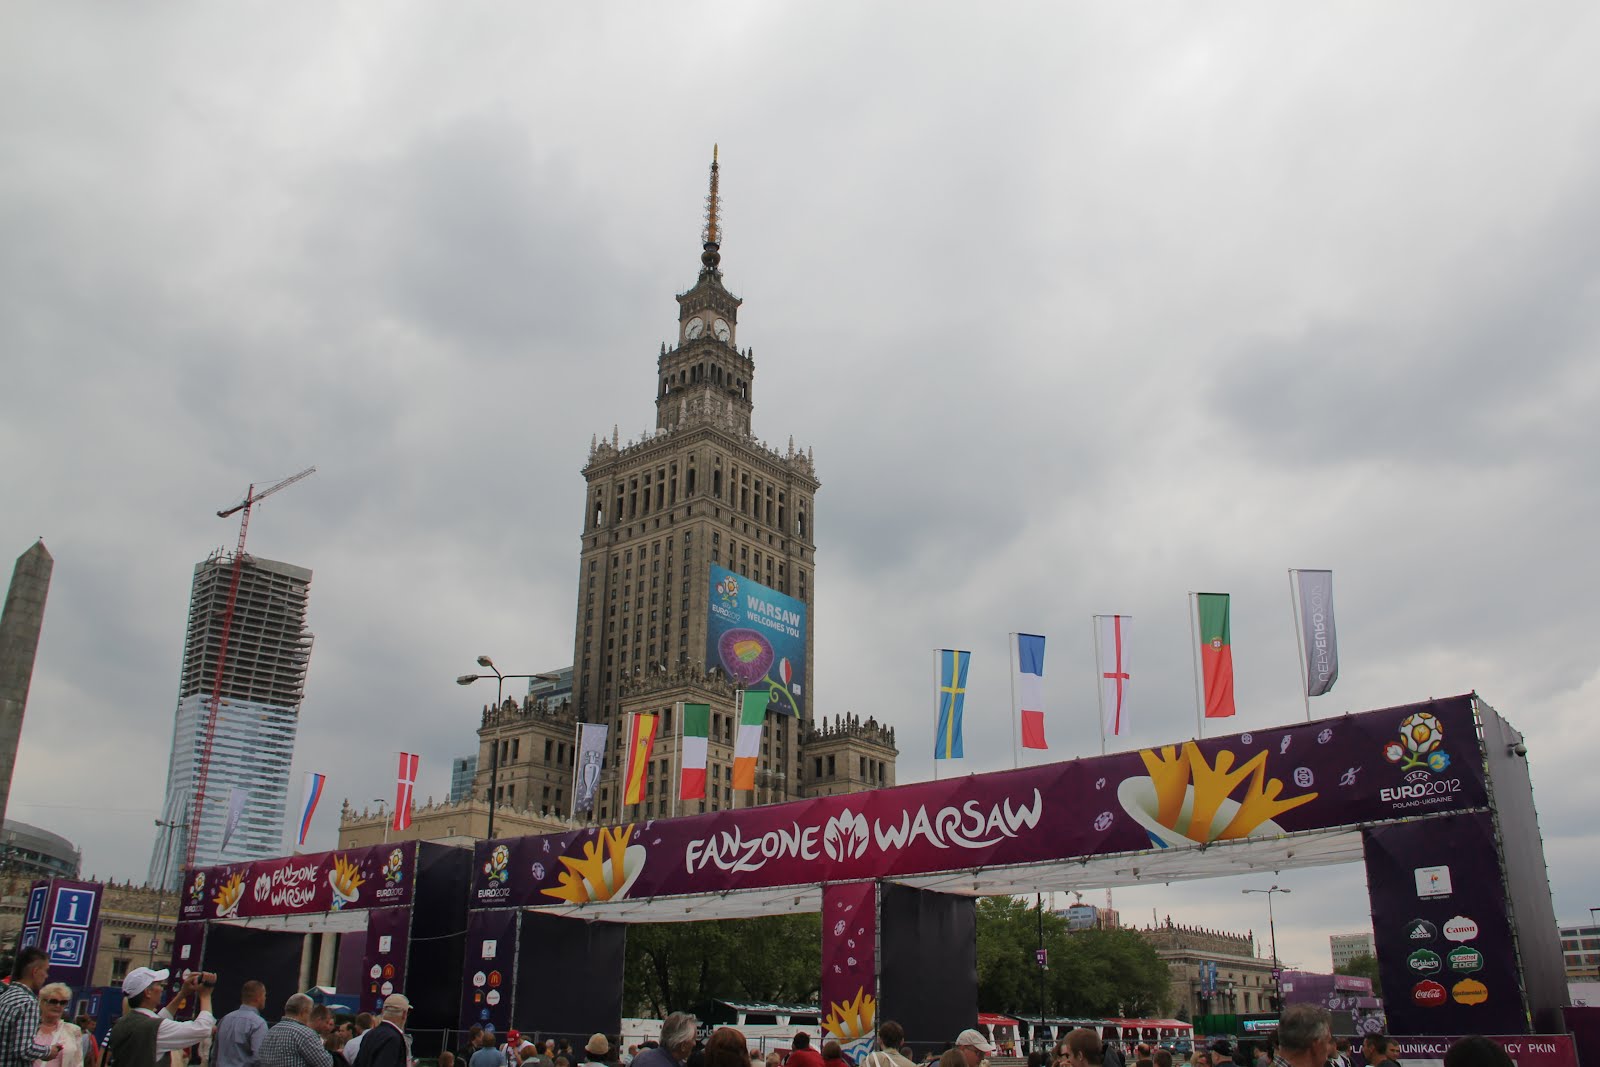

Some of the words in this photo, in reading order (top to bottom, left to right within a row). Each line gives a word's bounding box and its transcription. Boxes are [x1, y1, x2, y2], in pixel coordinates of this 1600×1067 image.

[747, 595, 801, 627] WARSAW
[747, 611, 785, 632] WELCOMES
[785, 625, 800, 638] YOU
[1406, 772, 1429, 782] UEFA
[1380, 778, 1462, 801] EURO2012
[685, 820, 821, 875] FANZONE
[874, 787, 1043, 850] WARSAW
[271, 863, 319, 887] FANZONE
[271, 884, 316, 908] WARSAW
[478, 887, 510, 898] EURO2012
[1446, 925, 1475, 934] Canon
[1409, 957, 1439, 971] Carlsberg
[1452, 961, 1479, 969] EDGE
[1503, 1043, 1521, 1053] ICY
[1528, 1043, 1556, 1053] PKIN
